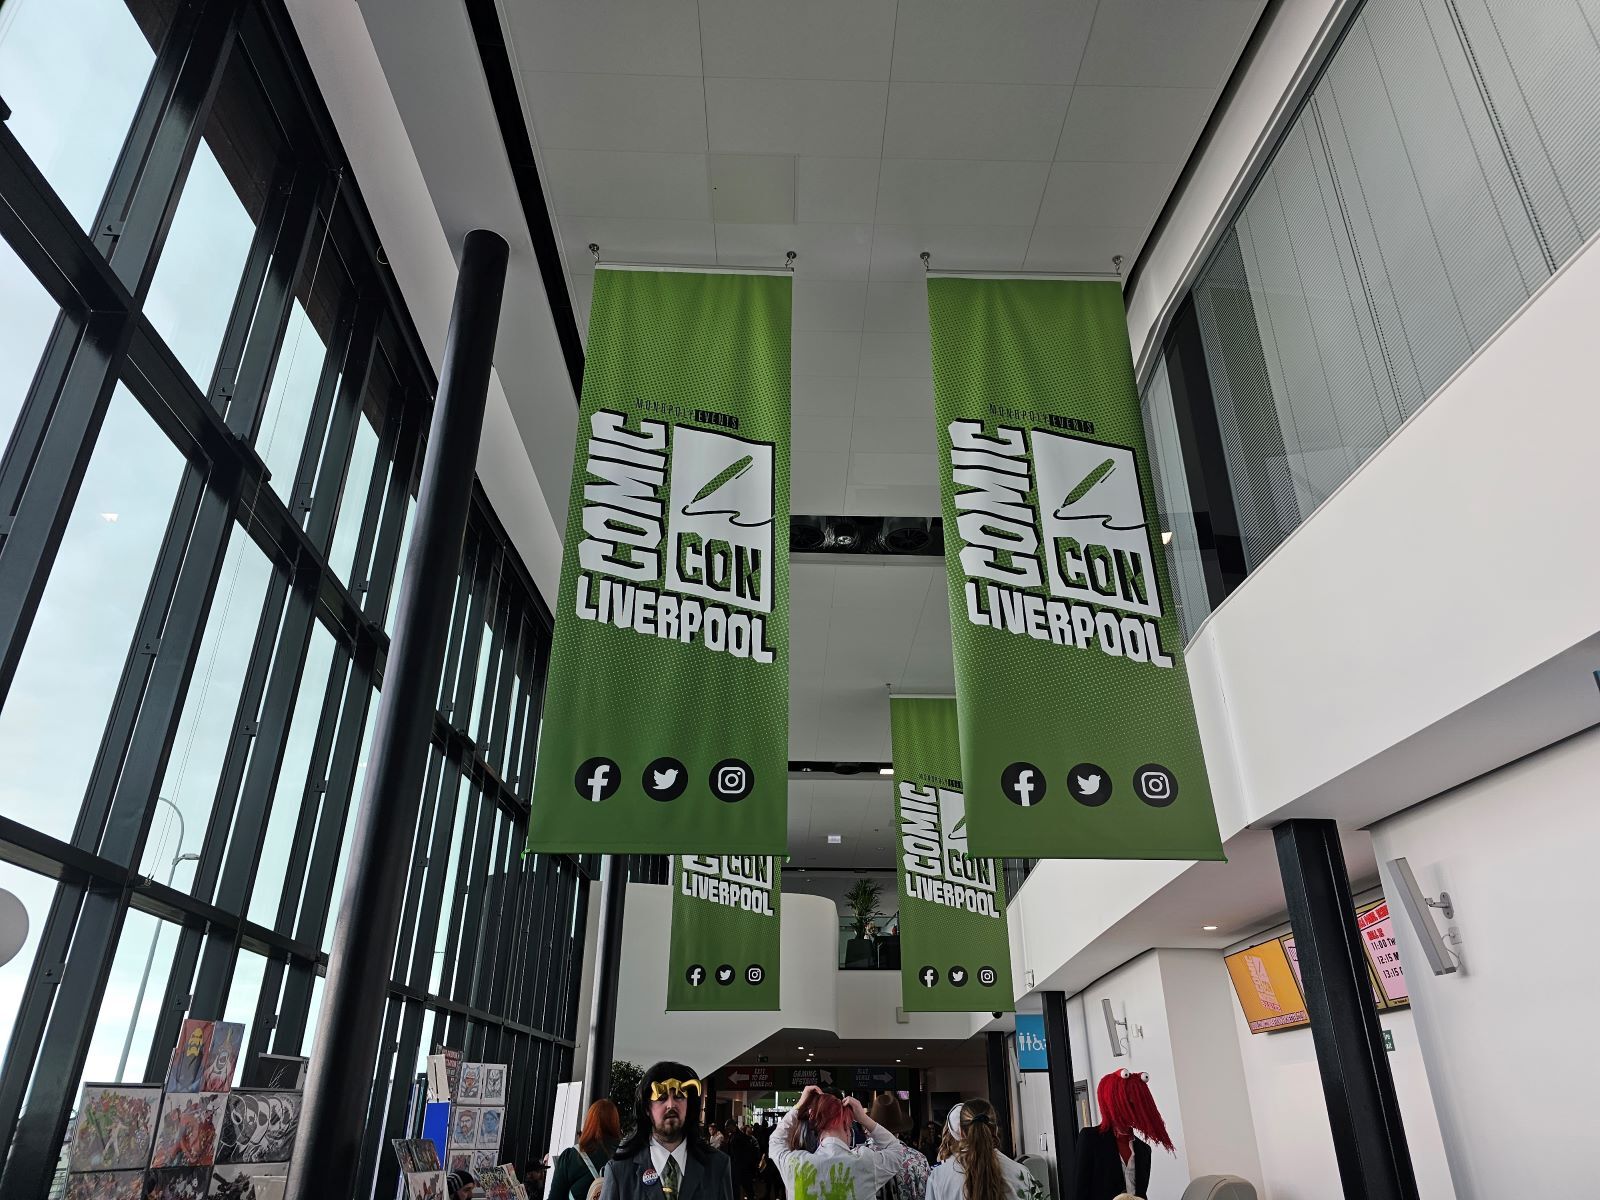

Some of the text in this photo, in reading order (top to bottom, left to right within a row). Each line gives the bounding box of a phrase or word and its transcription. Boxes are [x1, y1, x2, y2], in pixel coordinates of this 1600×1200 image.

[697, 410, 739, 429] EVENTS
[1050, 415, 1094, 434] EVENTS
[577, 408, 669, 581] COMIC
[948, 418, 1043, 587] COMIC
[676, 532, 762, 602] CON
[1053, 536, 1149, 606] CON
[576, 572, 776, 663] LIVERPOOL
[965, 578, 1175, 668] LIVERPOOL
[899, 780, 944, 877] COMIC
[682, 869, 774, 917] LIVERPOOL
[905, 870, 1001, 919] LIVERPOOL
[1377, 953, 1393, 964] 12:15
[1383, 968, 1399, 978] 13:15
[793, 1069, 817, 1077] GAMING
